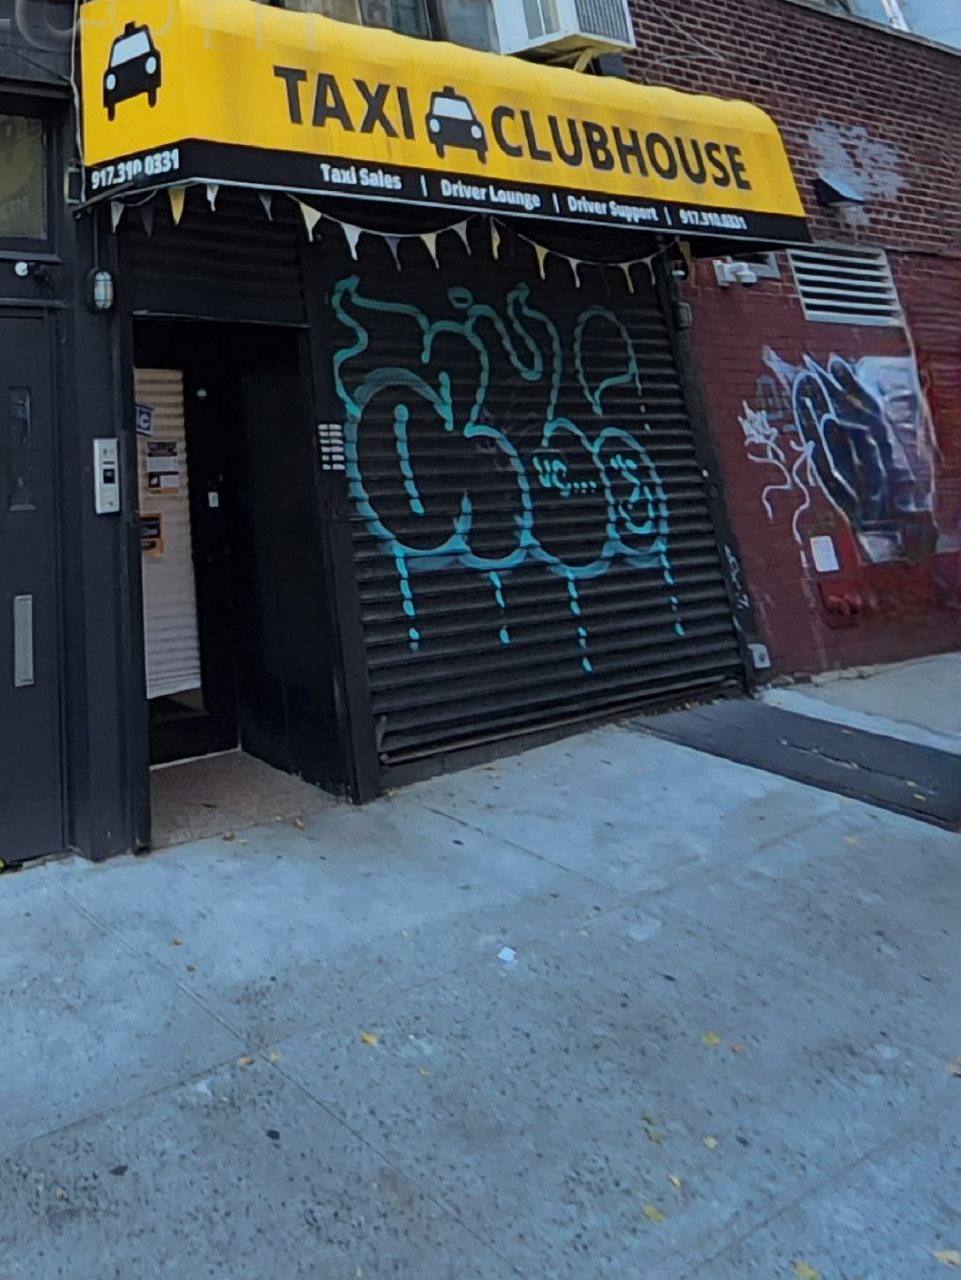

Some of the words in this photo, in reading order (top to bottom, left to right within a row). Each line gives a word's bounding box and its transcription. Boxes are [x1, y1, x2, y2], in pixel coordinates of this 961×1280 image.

[273, 65, 416, 141] TAXI
[491, 105, 753, 191] CLUBHOUSE
[320, 163, 357, 185] Taxi
[359, 166, 402, 190] Sales
[440, 178, 487, 200] Driver
[489, 184, 541, 211] Lounge
[567, 195, 608, 215] Driver
[609, 201, 659, 224] Support
